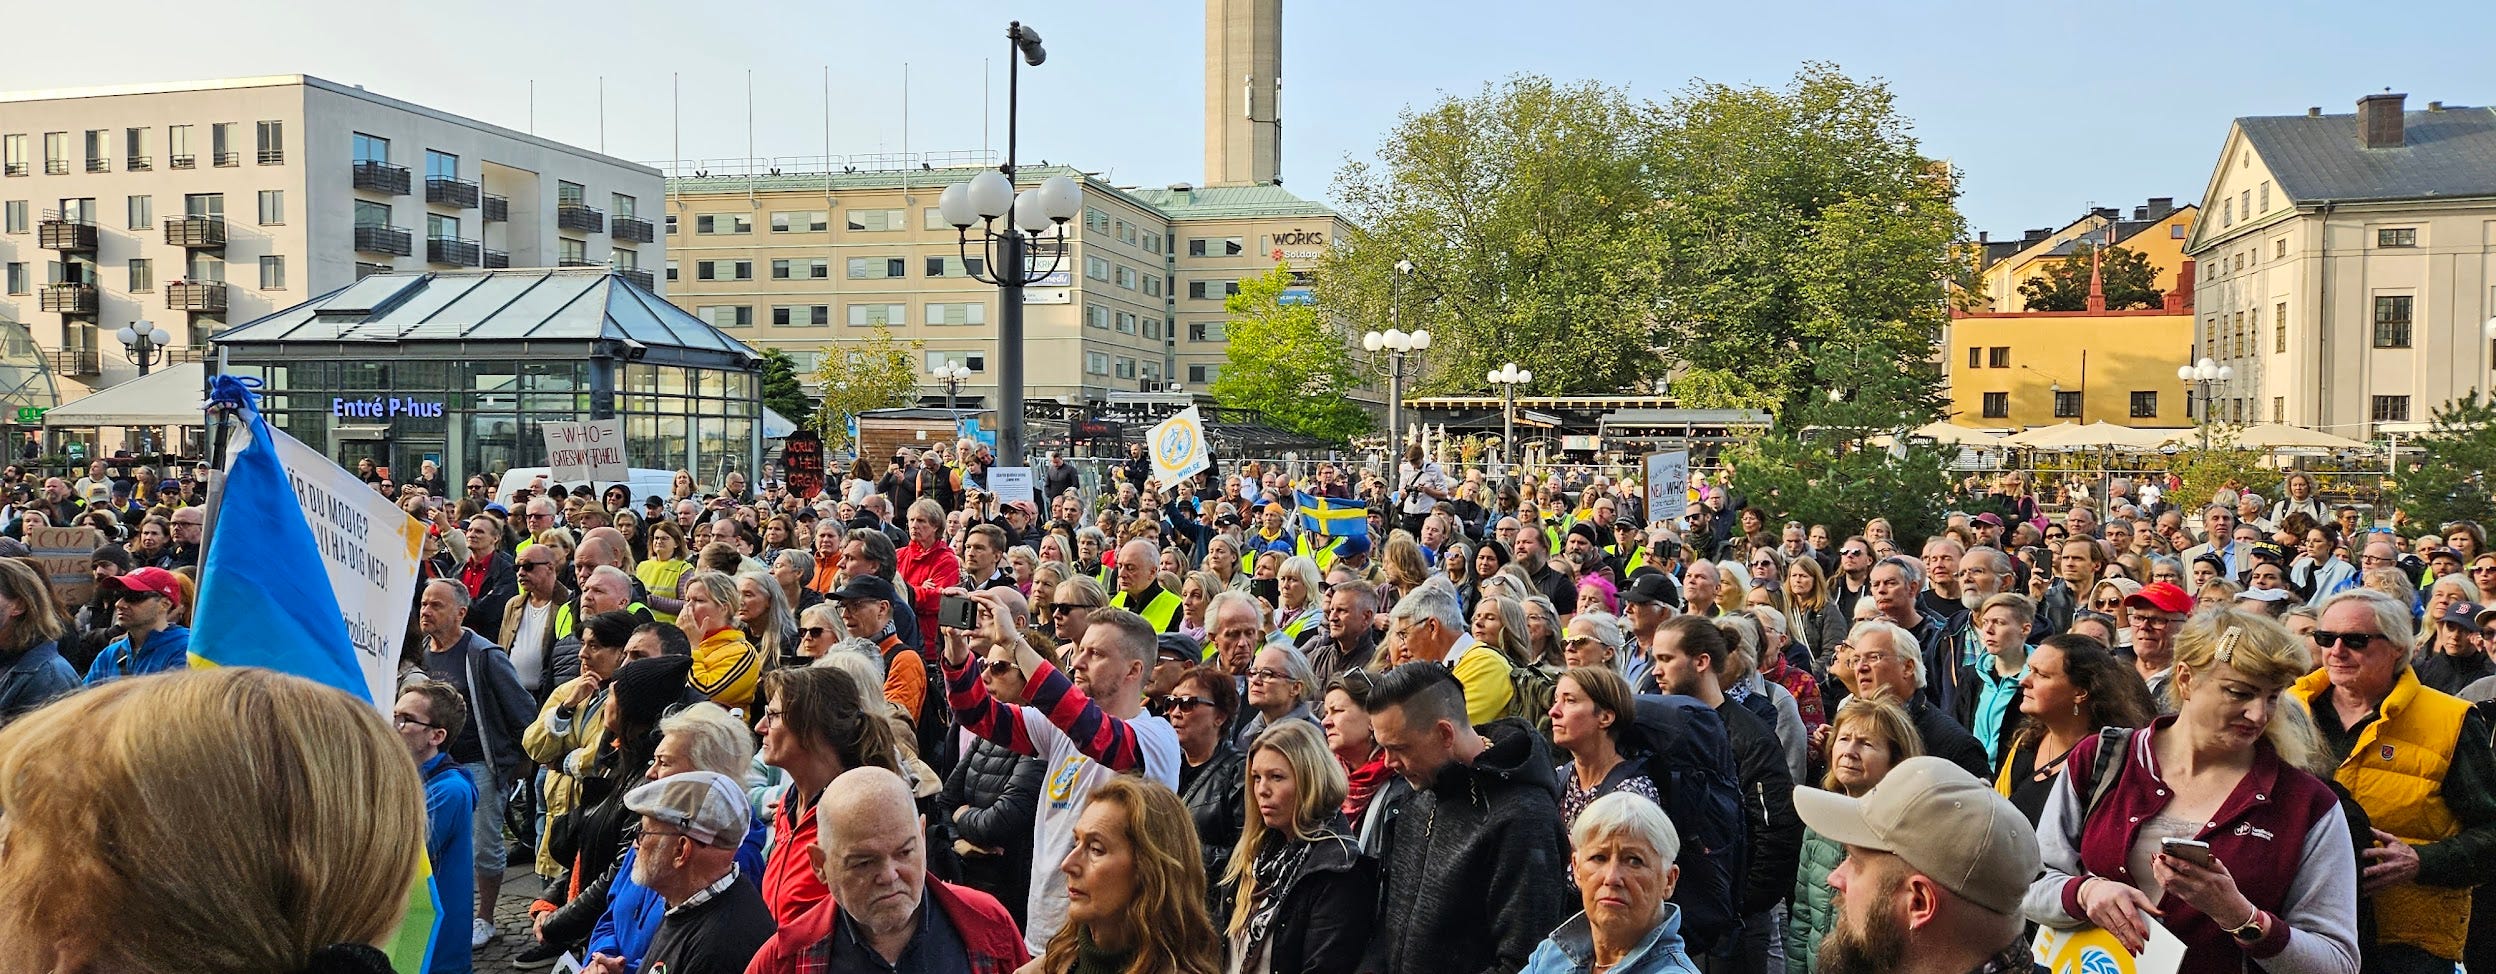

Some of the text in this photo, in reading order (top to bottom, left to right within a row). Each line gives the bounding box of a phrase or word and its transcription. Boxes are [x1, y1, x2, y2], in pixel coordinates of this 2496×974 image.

[1272, 228, 1323, 245] WORKS
[333, 396, 442, 417] Entré P-hus
[309, 483, 325, 517] DU
[328, 494, 369, 543] MODIG?
[331, 531, 346, 565] HA
[348, 541, 365, 576] DIG
[367, 553, 388, 592] MED!
